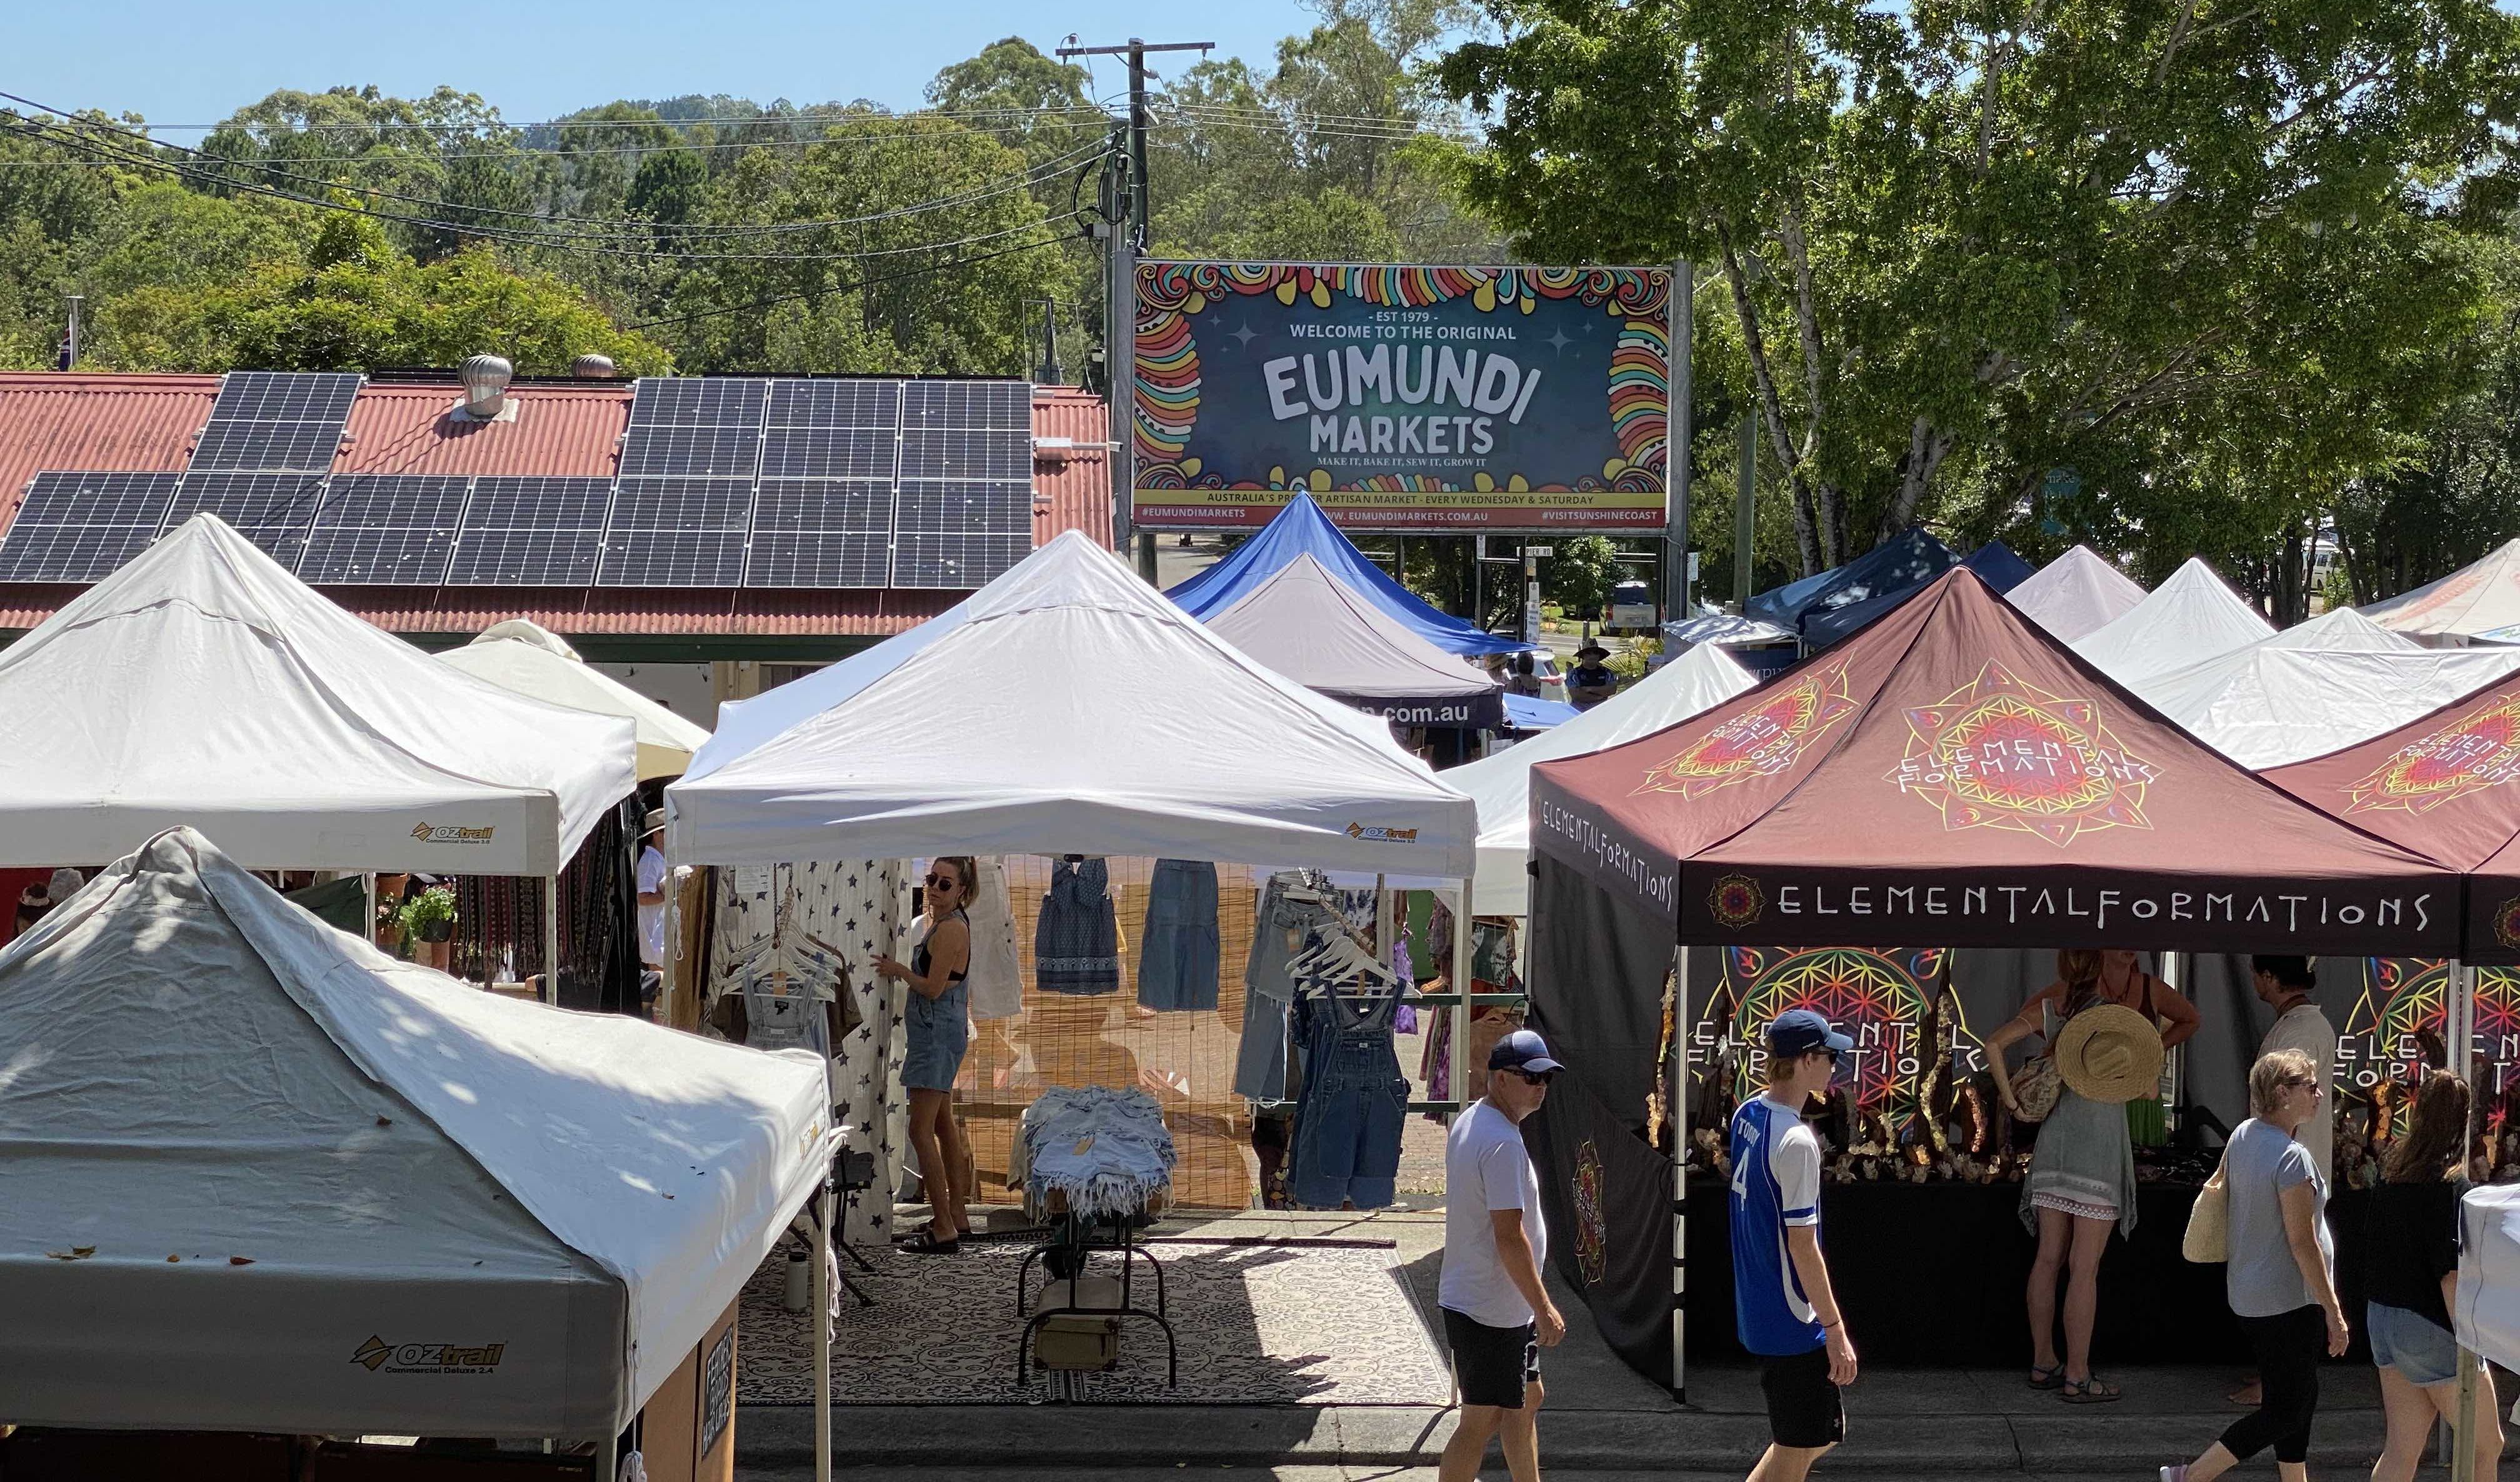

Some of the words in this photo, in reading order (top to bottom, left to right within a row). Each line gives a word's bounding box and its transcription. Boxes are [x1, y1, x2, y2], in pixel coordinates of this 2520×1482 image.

[1376, 312, 1398, 322] EST
[1401, 312, 1430, 322] 1979
[1289, 324, 1371, 338] WELCOME
[1376, 326, 1396, 338] TO
[1400, 326, 1432, 339] THE
[1437, 326, 1517, 340] ORIGINAL
[1262, 344, 1542, 425] EUMUNDI
[1310, 415, 1494, 454] MARKETS
[1318, 457, 1347, 465] MAKE
[1349, 458, 1361, 467] IT,
[1364, 458, 1390, 467] BAKE
[1392, 458, 1404, 467] IT,
[1406, 458, 1428, 467] SEW
[1429, 458, 1442, 467] IT,
[1444, 458, 1474, 467] GROW
[1476, 459, 1486, 467] IT
[1208, 494, 1275, 503] AUSTRALIA'S
[1326, 495, 1371, 504] ARTISAN
[1375, 495, 1417, 504] MARKET
[1426, 495, 1457, 505] EVERY
[1459, 495, 1526, 505] WEDNESDAY
[1528, 495, 1535, 504] &
[1539, 495, 1594, 505] SATURDAY
[1142, 509, 1245, 518] #EUMUNDIMARKETS
[1349, 512, 1488, 521] EUMUNDIMARKETS.COM.AU
[1542, 511, 1658, 520] #VISITSUNSHINECOAST
[1900, 739, 2140, 773] ELEMENTAL
[1898, 757, 2154, 793] FORMATIONS
[1543, 801, 1672, 912] ELEMENTALFORMATIONS
[1778, 886, 2431, 933] ELEMENTALFORMATIONS
[1731, 1146, 1749, 1211] 4
[396, 1343, 505, 1366] OZtrail
